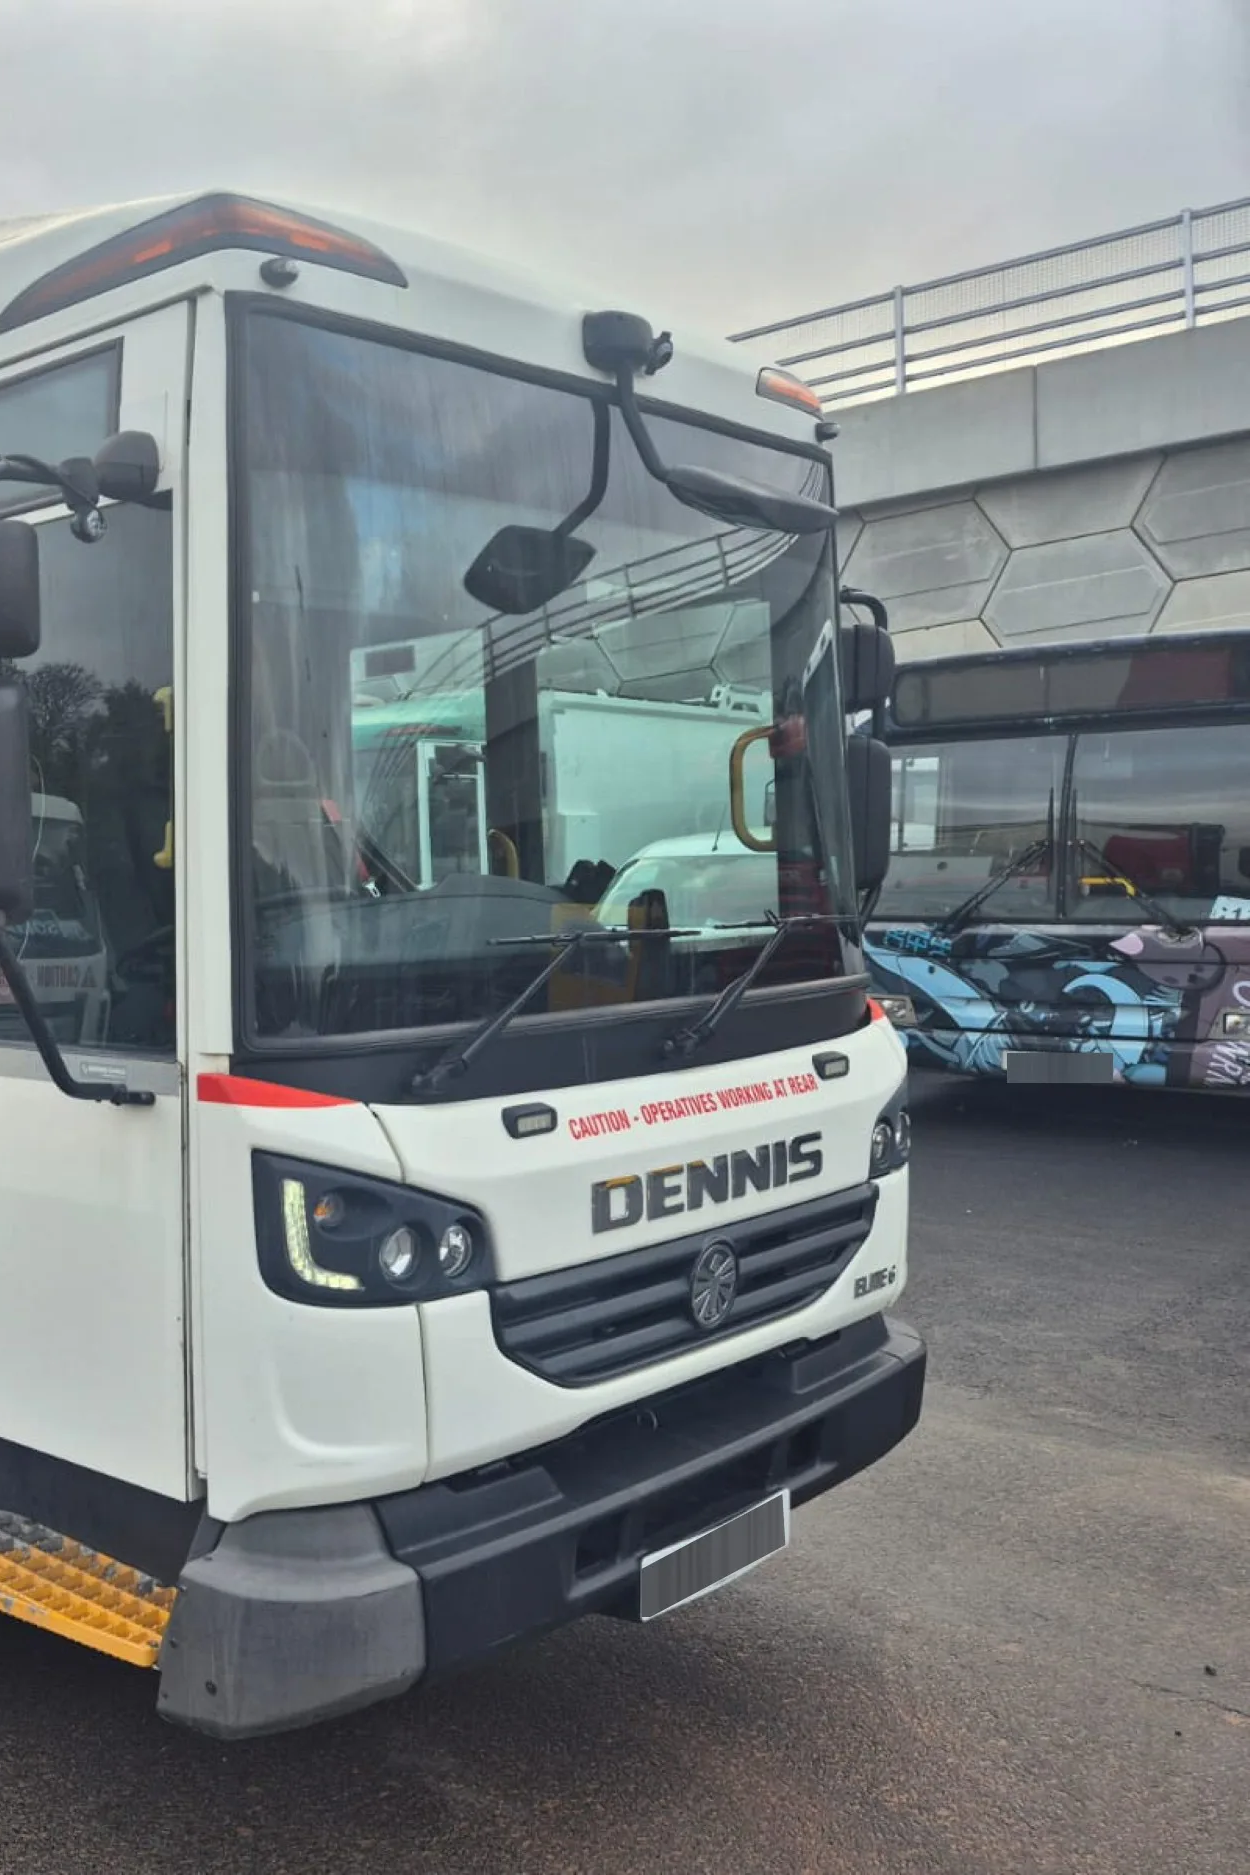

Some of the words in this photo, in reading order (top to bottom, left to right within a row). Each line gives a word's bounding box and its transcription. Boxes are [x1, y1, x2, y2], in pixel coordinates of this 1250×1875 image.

[568, 1109, 631, 1140] CAUTION
[640, 1092, 718, 1125] OPERATIVES
[716, 1082, 774, 1110] WORKING
[772, 1078, 788, 1099] AT
[787, 1072, 819, 1096] REAR
[591, 1130, 824, 1235] DENNIS
